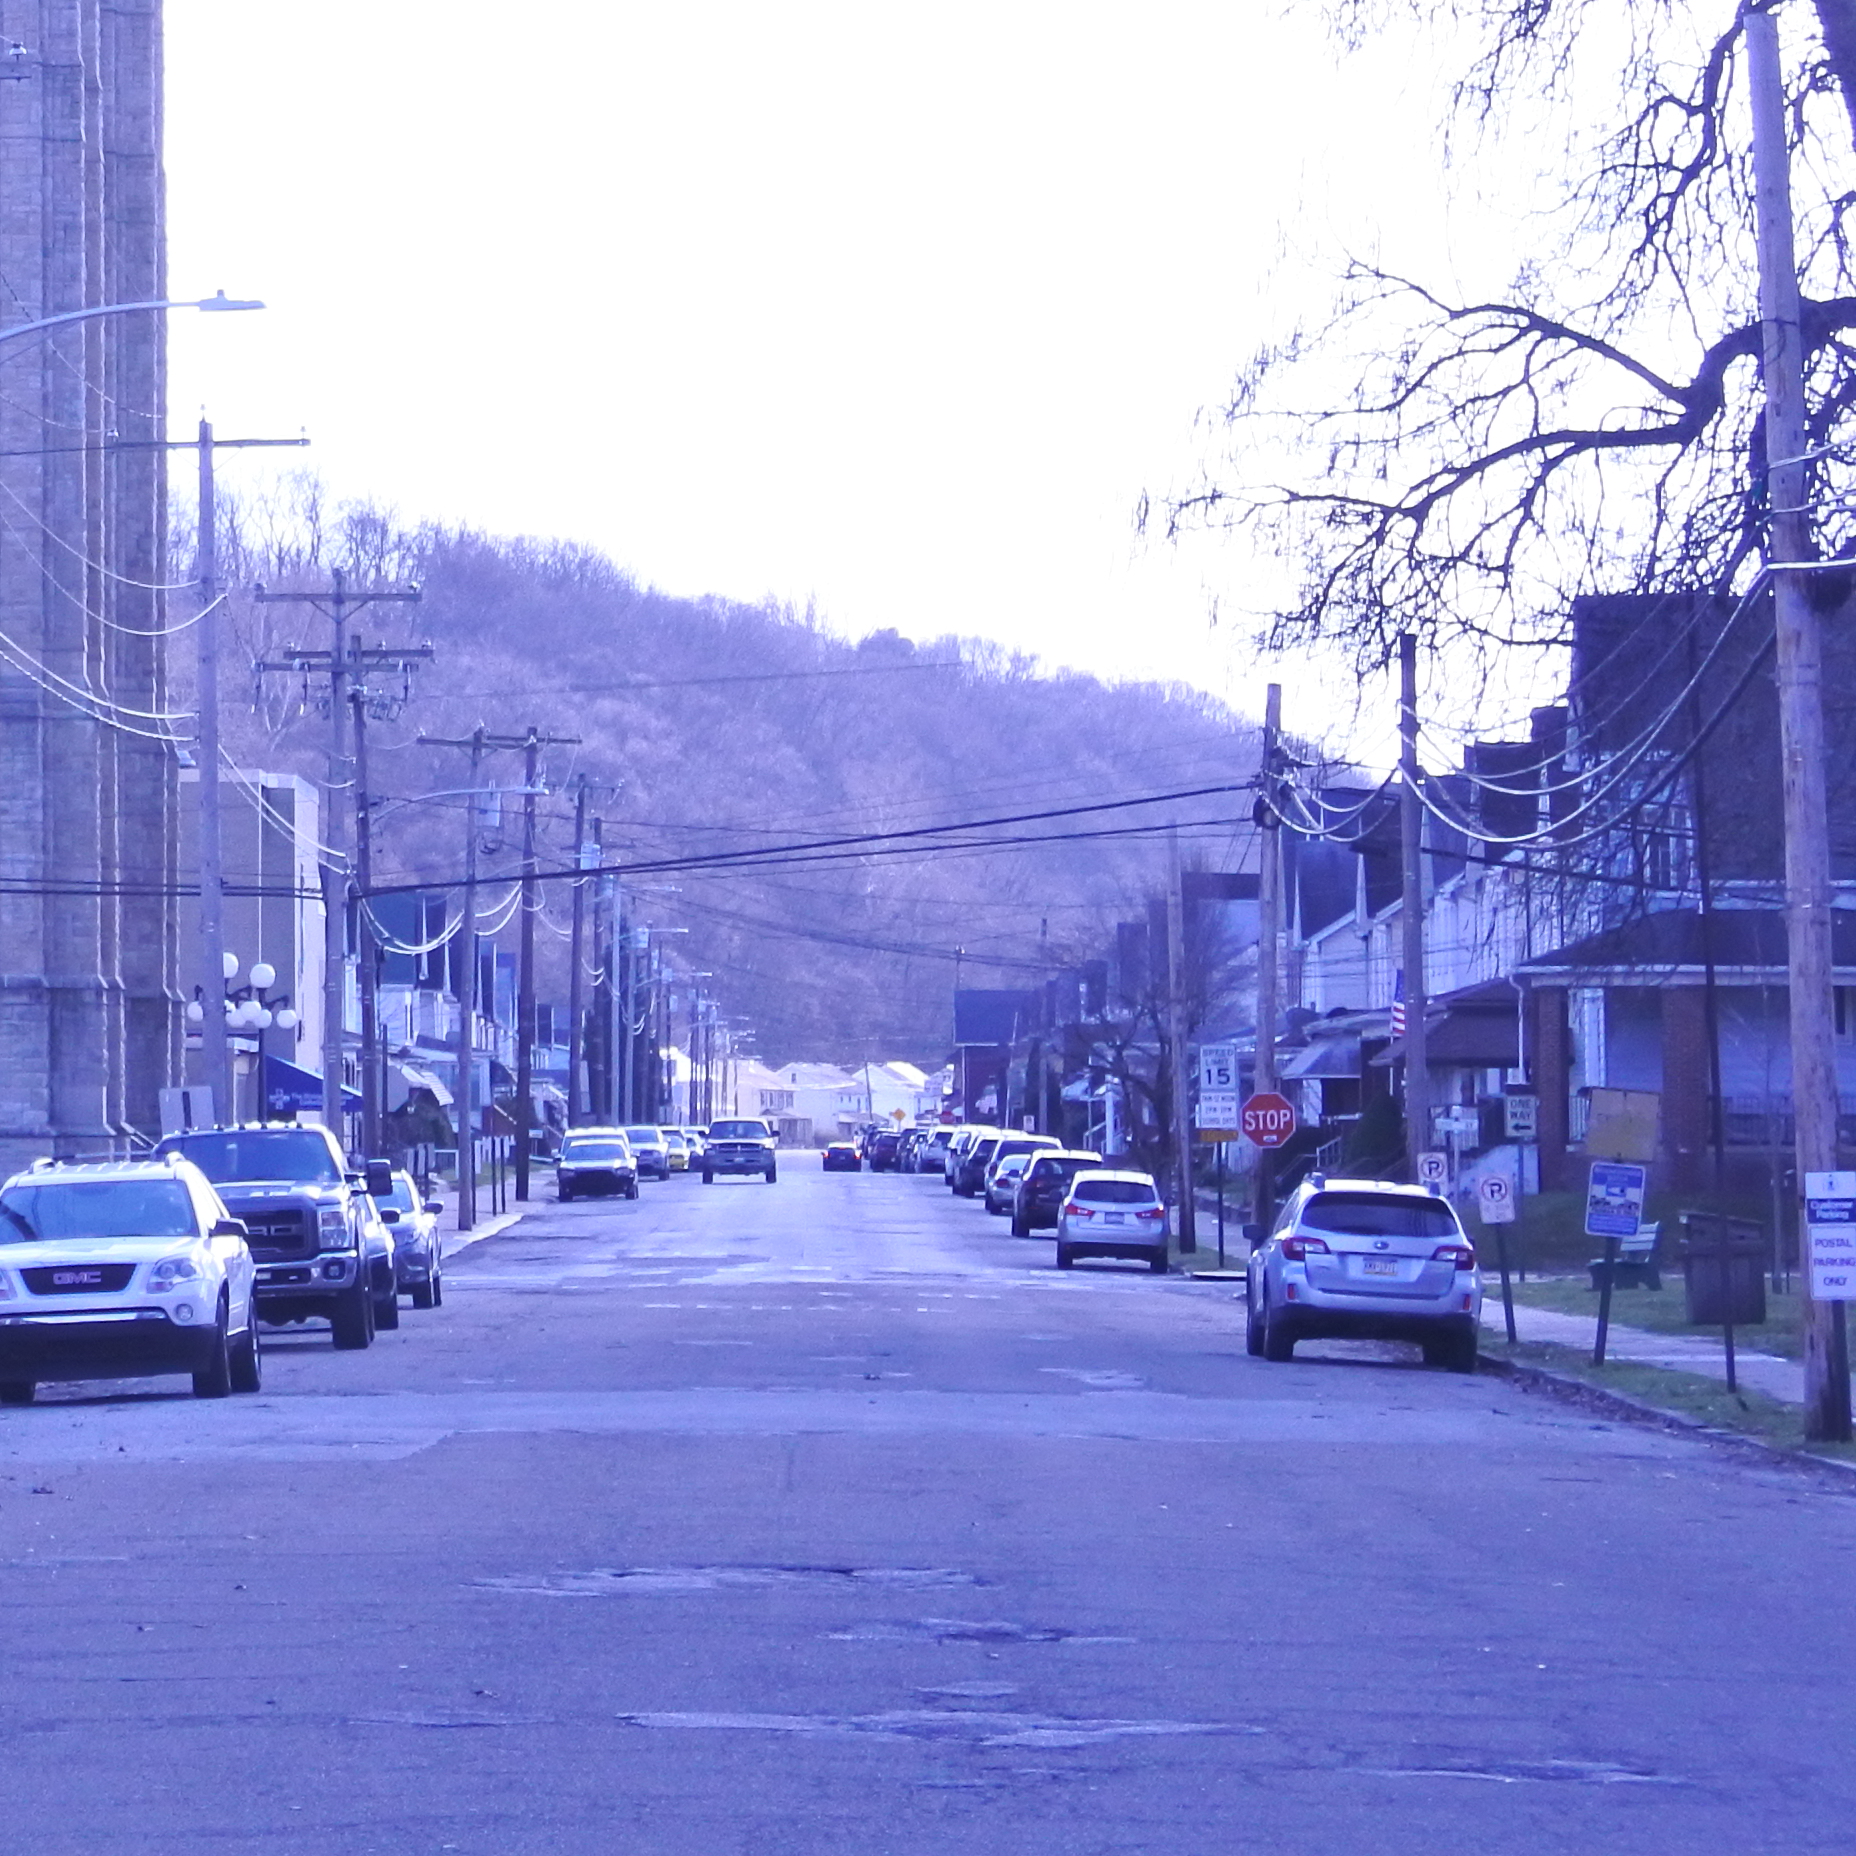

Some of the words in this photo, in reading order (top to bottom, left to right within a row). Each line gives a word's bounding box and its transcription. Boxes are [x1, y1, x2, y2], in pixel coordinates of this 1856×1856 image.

[1202, 1048, 1234, 1057] SPEED
[1205, 1058, 1228, 1066] LIMIT
[1206, 1068, 1230, 1085] 15
[1510, 1099, 1531, 1109] ONE
[1245, 1109, 1291, 1131] STOP
[1510, 1111, 1531, 1120] WAY
[1814, 1238, 1852, 1248] POSTAL
[1813, 1257, 1856, 1266] PARKING
[53, 1271, 101, 1284] GMC
[1823, 1276, 1847, 1286] ONLY
